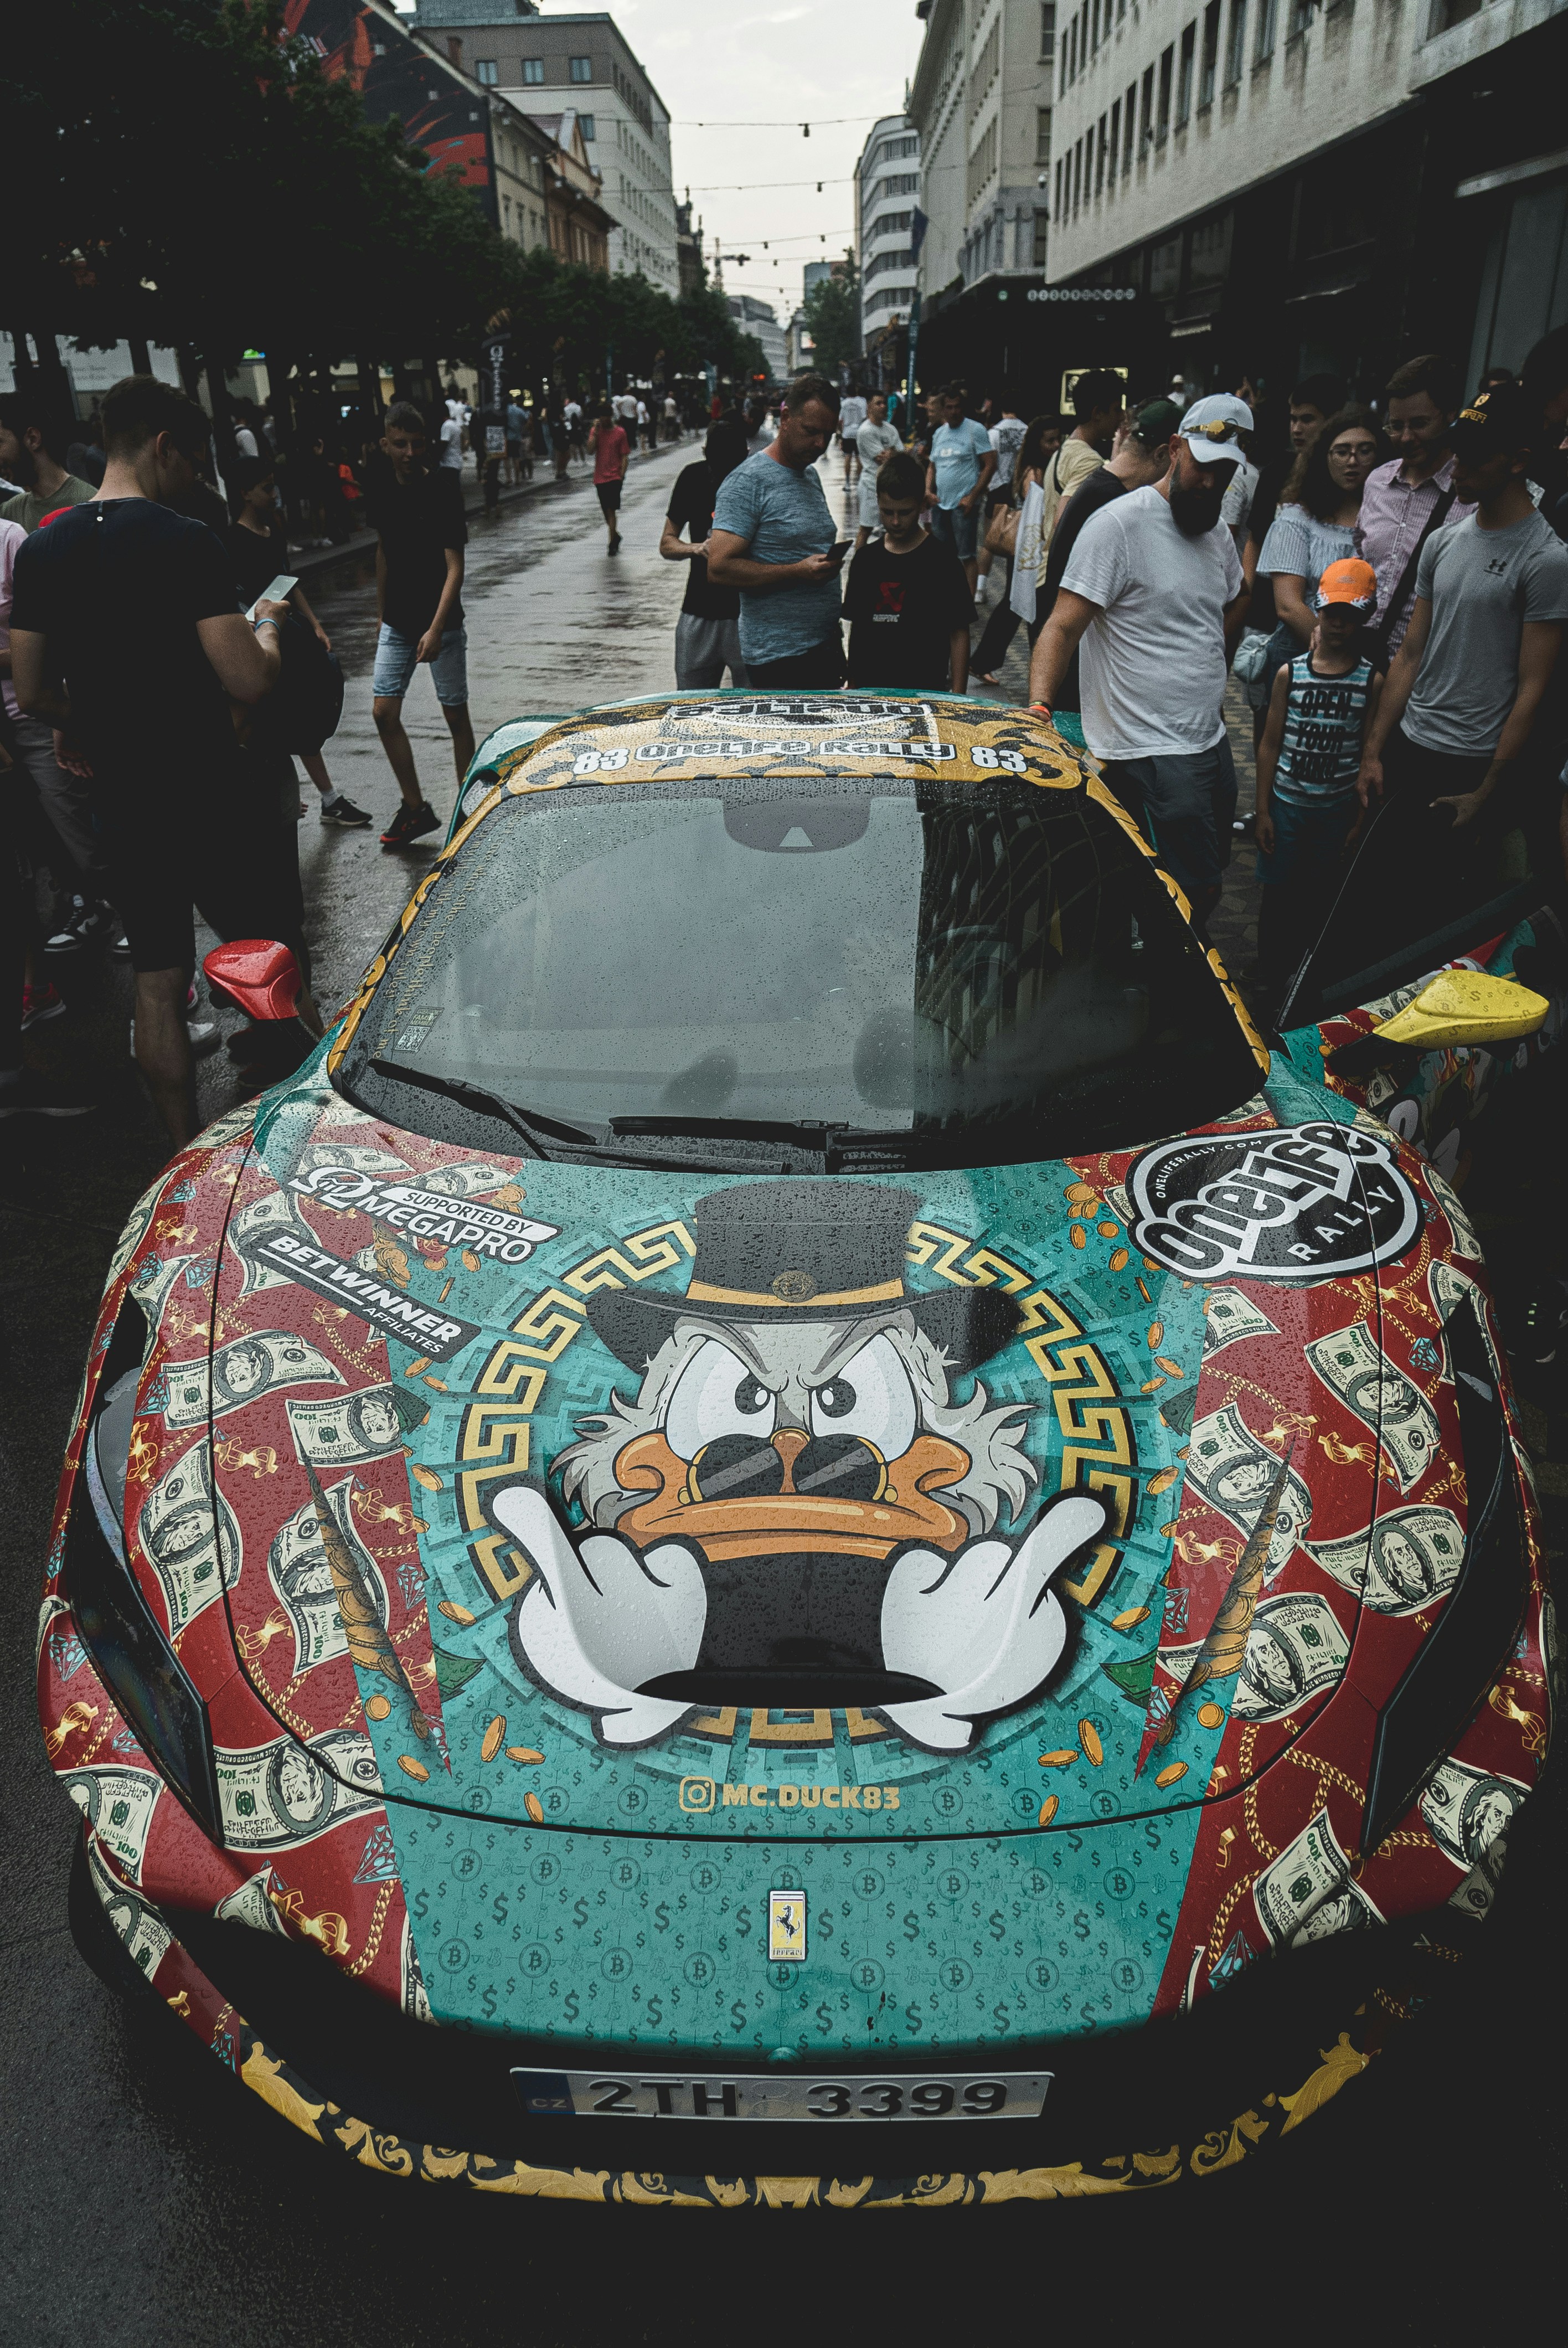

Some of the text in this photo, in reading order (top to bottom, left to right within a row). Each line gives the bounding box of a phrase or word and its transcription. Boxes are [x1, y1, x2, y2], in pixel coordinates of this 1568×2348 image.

[1301, 690, 1352, 720] OPEN
[1296, 722, 1346, 753] YOUR
[572, 748, 629, 775] 83
[971, 746, 1027, 773] 83
[1291, 750, 1339, 779] MIND
[462, 841, 482, 857] my
[451, 858, 476, 876] life
[463, 864, 487, 891] what
[434, 881, 455, 905] with
[419, 909, 439, 927] my
[441, 894, 466, 928] other
[406, 930, 426, 956] own
[417, 931, 445, 976] people
[394, 979, 423, 1016] think
[383, 1019, 399, 1034] of
[372, 1038, 389, 1059] me
[403, 1192, 534, 1234] SUPPORTED BY
[1287, 1185, 1396, 1262] RALLY
[355, 1194, 532, 1261] MEGAPRO
[267, 1235, 462, 1343] BETWINNER
[363, 1306, 445, 1354] AFFILIATES
[178, 1590, 189, 1619] 100
[313, 1634, 325, 1660] 100
[722, 1783, 900, 1810] MC.DUCK83
[114, 1840, 138, 1860] 100
[530, 2097, 568, 2108] CZ
[587, 2079, 1008, 2117] 2TH 3399
